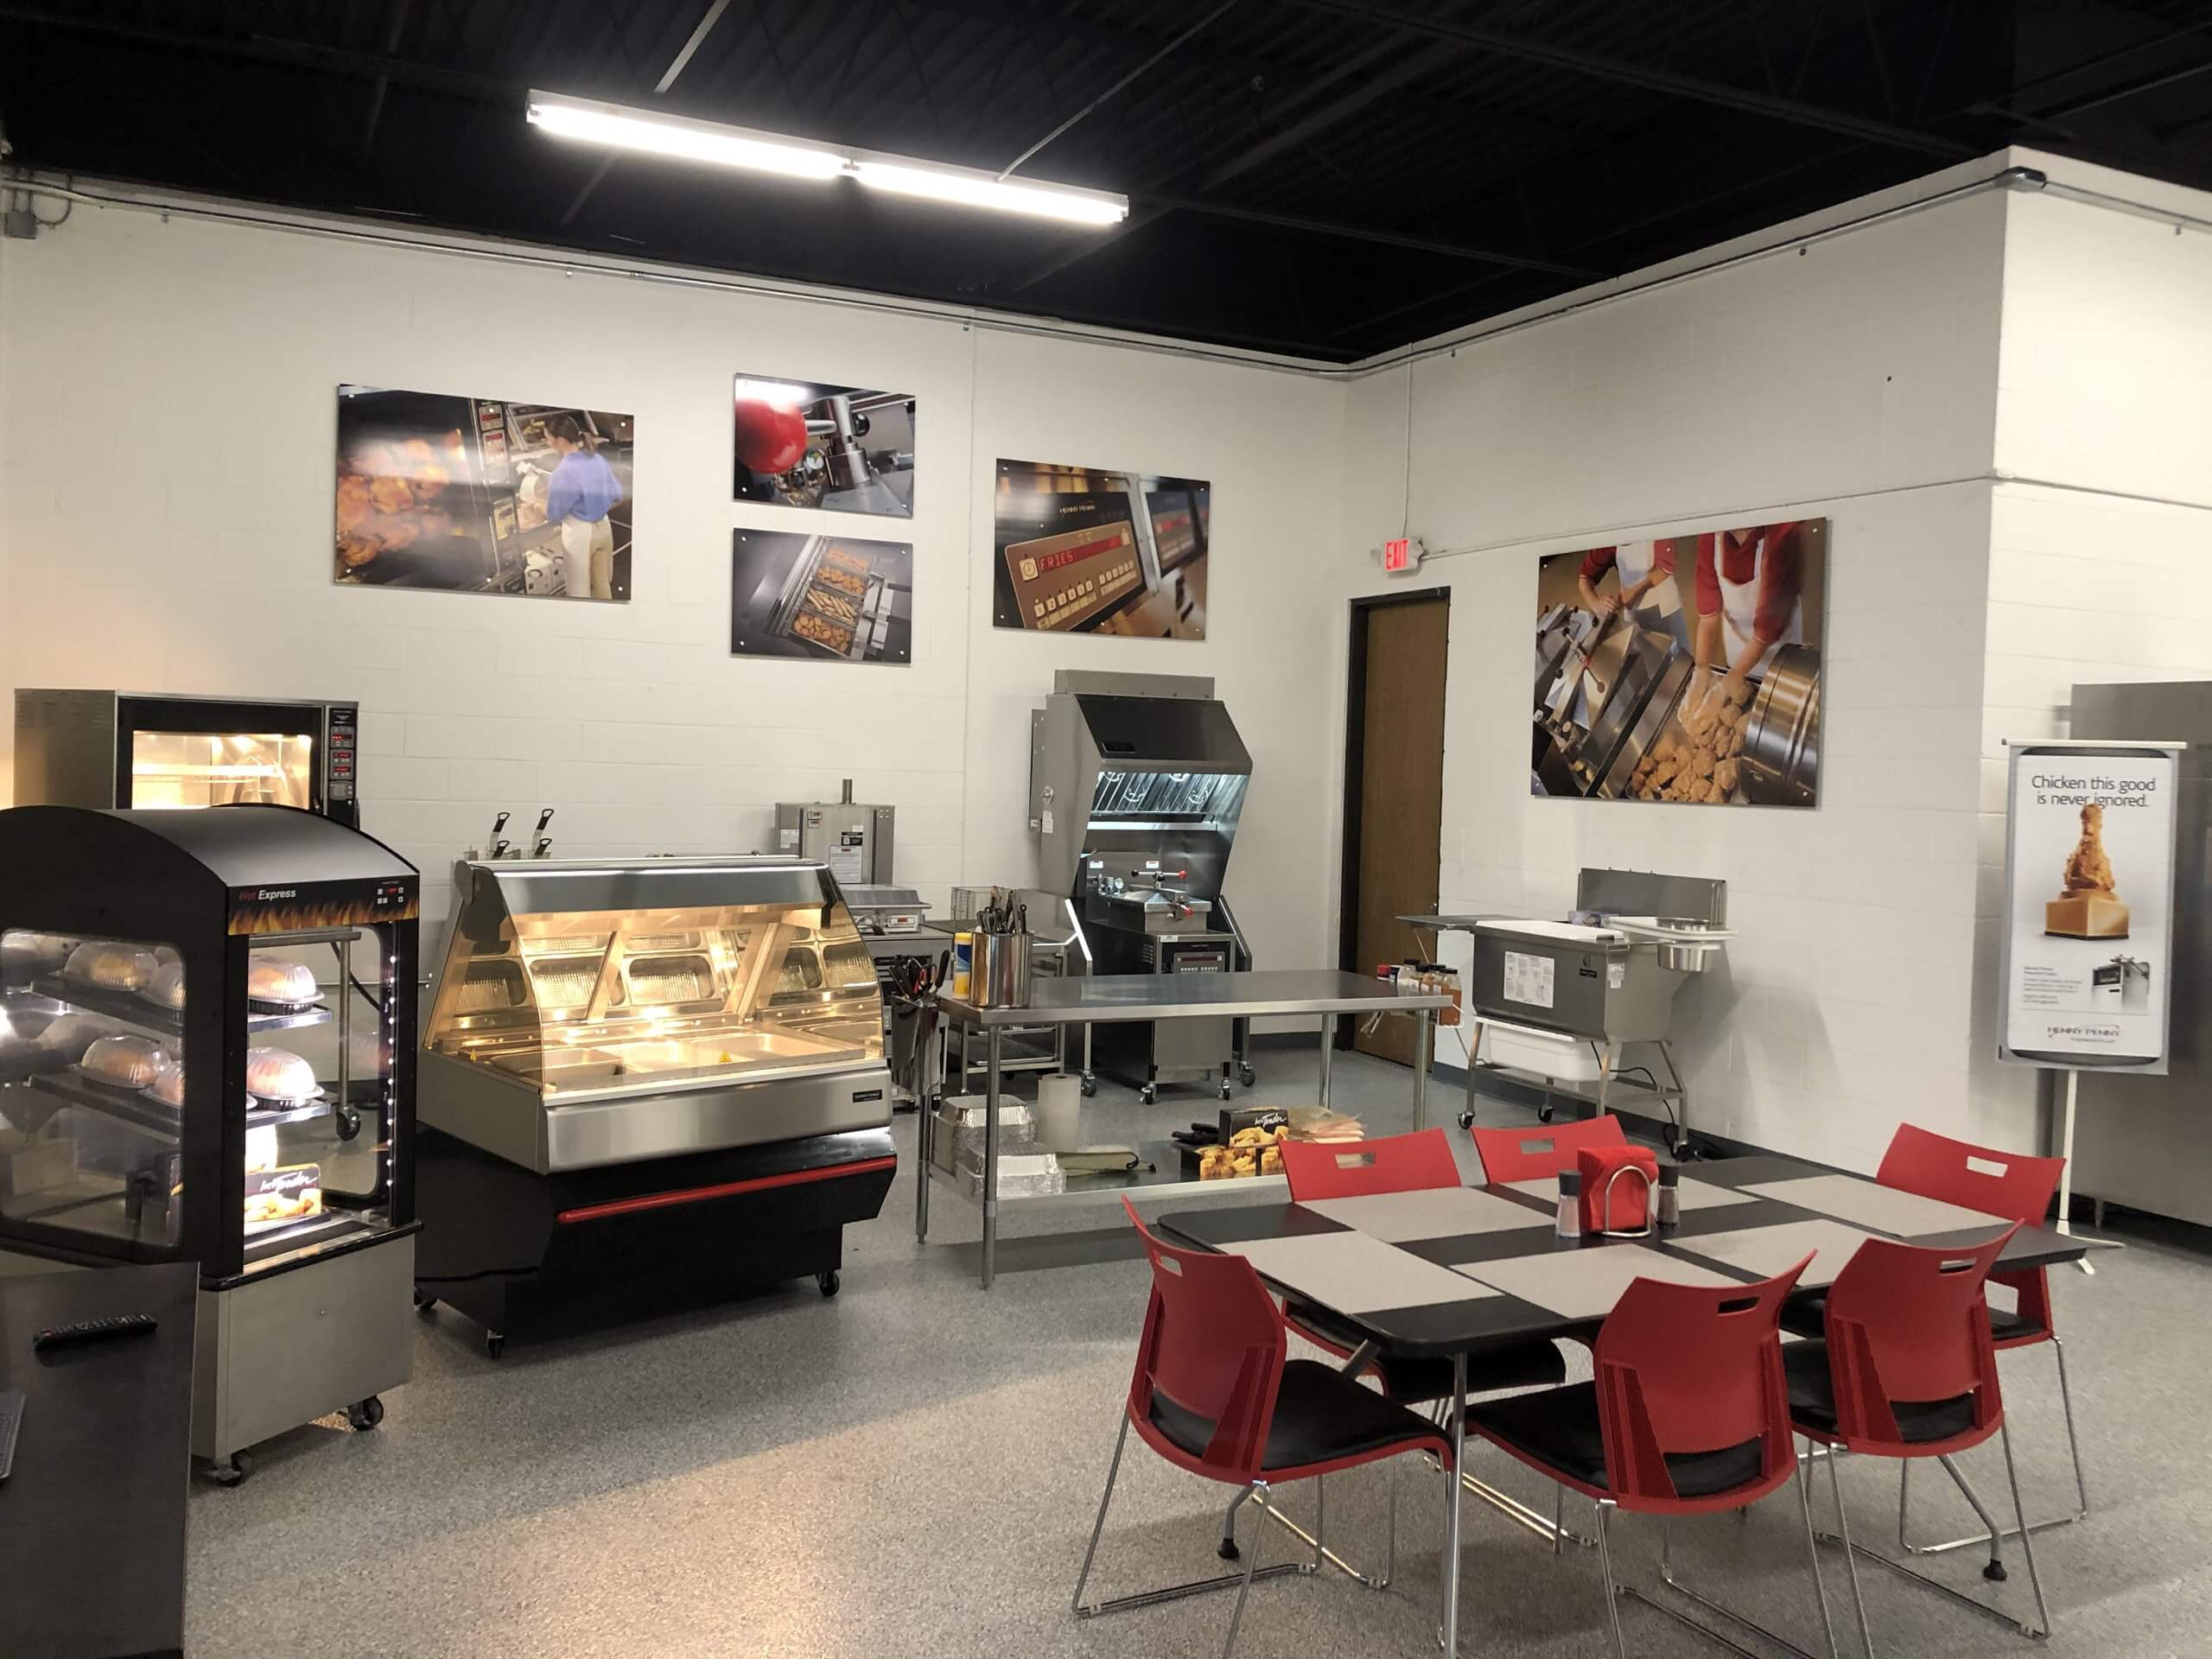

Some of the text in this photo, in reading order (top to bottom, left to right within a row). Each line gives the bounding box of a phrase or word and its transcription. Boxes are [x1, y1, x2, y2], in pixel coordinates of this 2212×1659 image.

[1039, 550, 1073, 571] FRIES
[2031, 774, 2157, 794] Chicken this good
[2037, 791, 2149, 809] is never ignored.
[258, 889, 296, 901] Express
